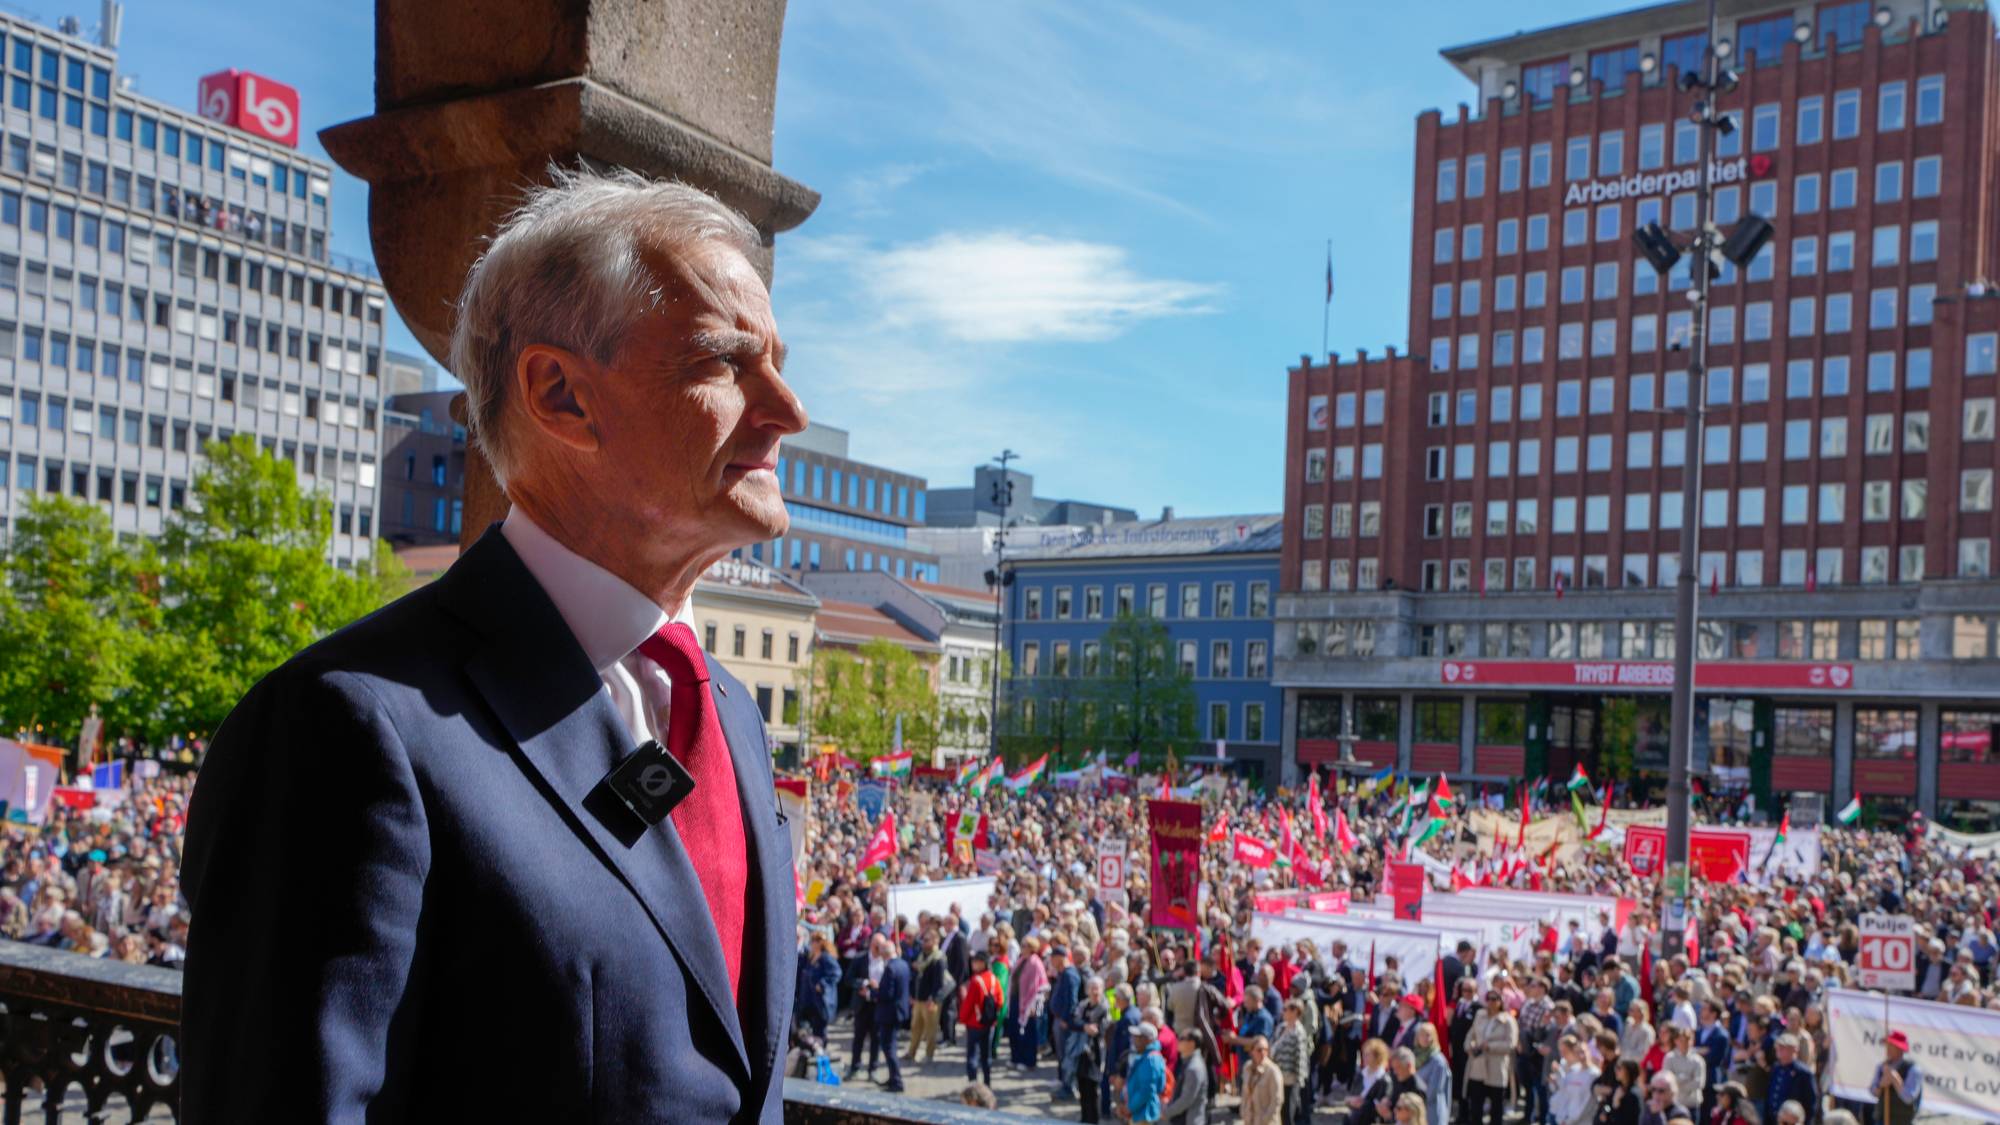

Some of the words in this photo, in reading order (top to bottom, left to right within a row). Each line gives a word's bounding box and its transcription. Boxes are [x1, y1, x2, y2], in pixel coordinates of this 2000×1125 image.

[245, 77, 292, 138] LO
[1574, 663, 1616, 683] TRYGT
[1103, 859, 1119, 886] 9
[1501, 924, 1528, 942] SV
[1865, 918, 1907, 933] Pulje
[1864, 938, 1909, 969] 10
[1928, 1044, 1947, 1058] ut
[1924, 1074, 1957, 1090] ern
